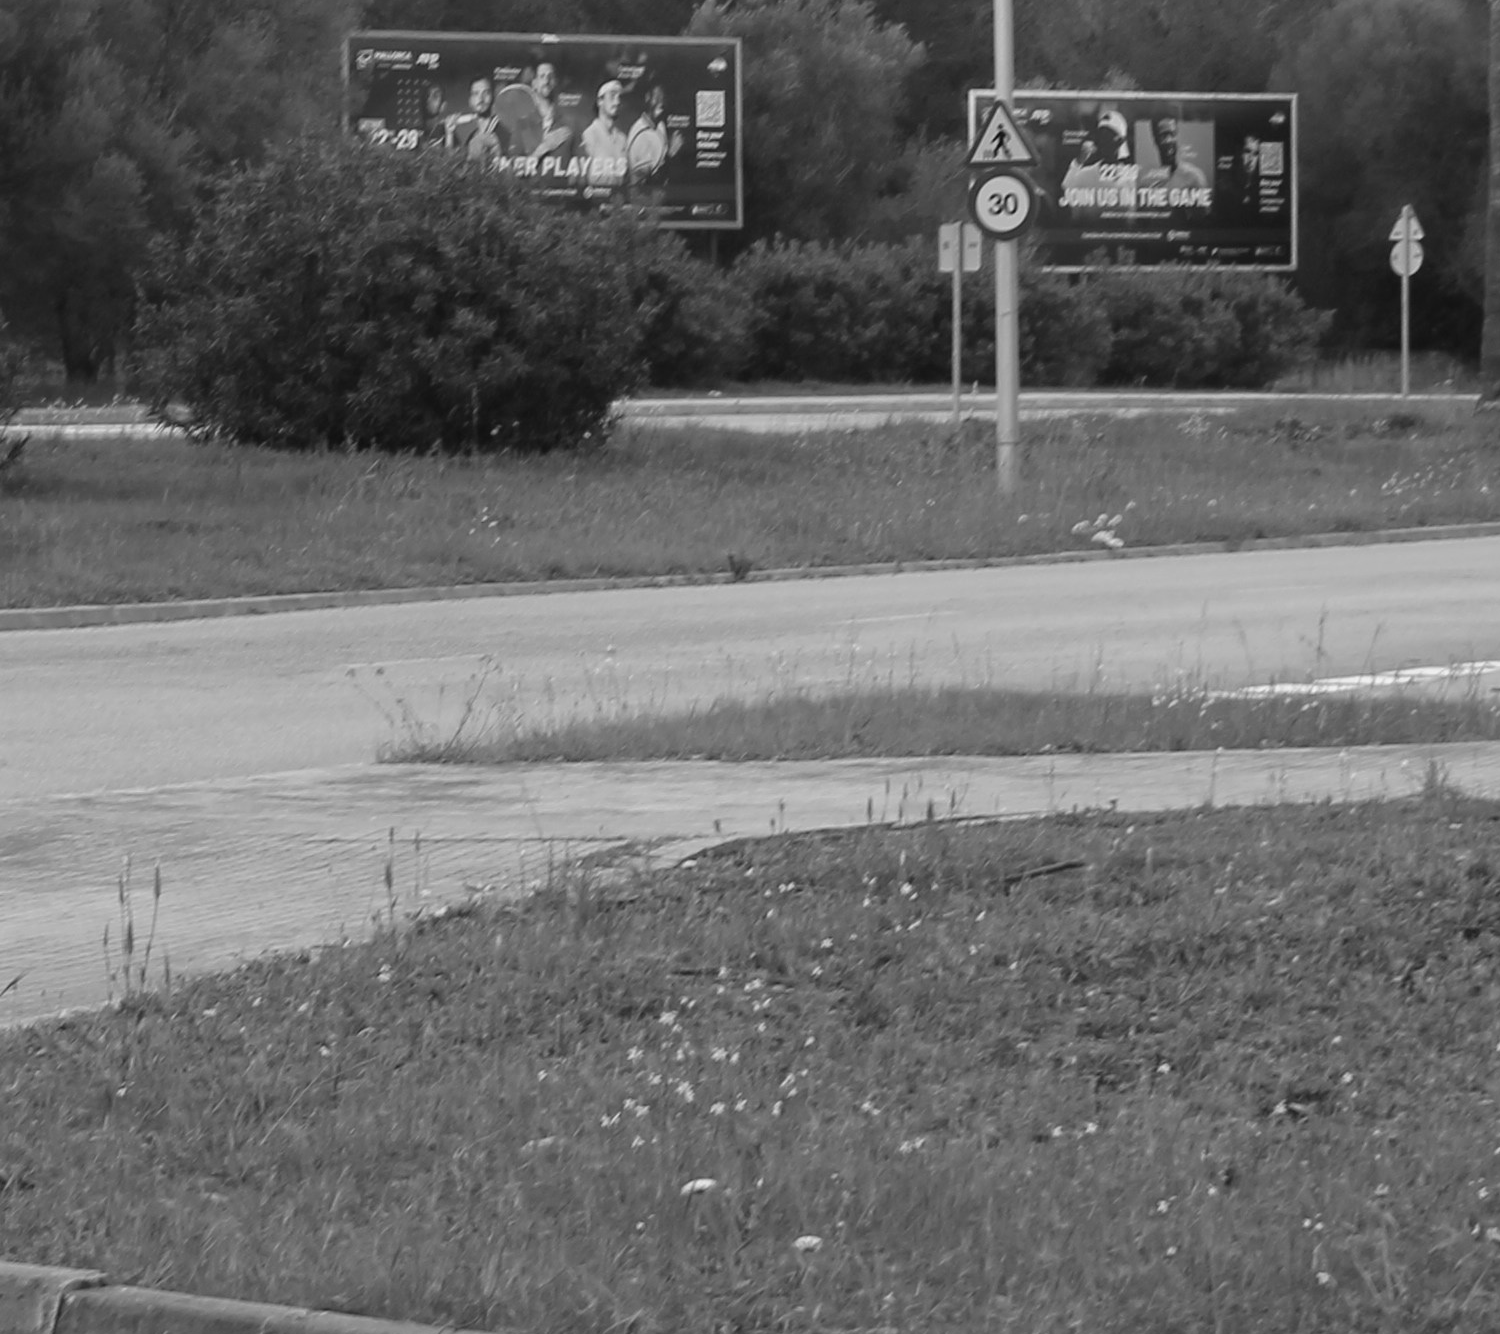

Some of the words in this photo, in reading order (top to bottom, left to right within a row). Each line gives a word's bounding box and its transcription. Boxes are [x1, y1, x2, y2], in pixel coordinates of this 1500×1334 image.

[541, 155, 628, 178] PLAYERS
[988, 192, 1019, 216] 30
[1058, 186, 1096, 208] JOIN
[1097, 186, 1119, 208] US
[1119, 186, 1137, 208] IN
[1137, 186, 1169, 208] THE
[1169, 186, 1213, 208] GAME
